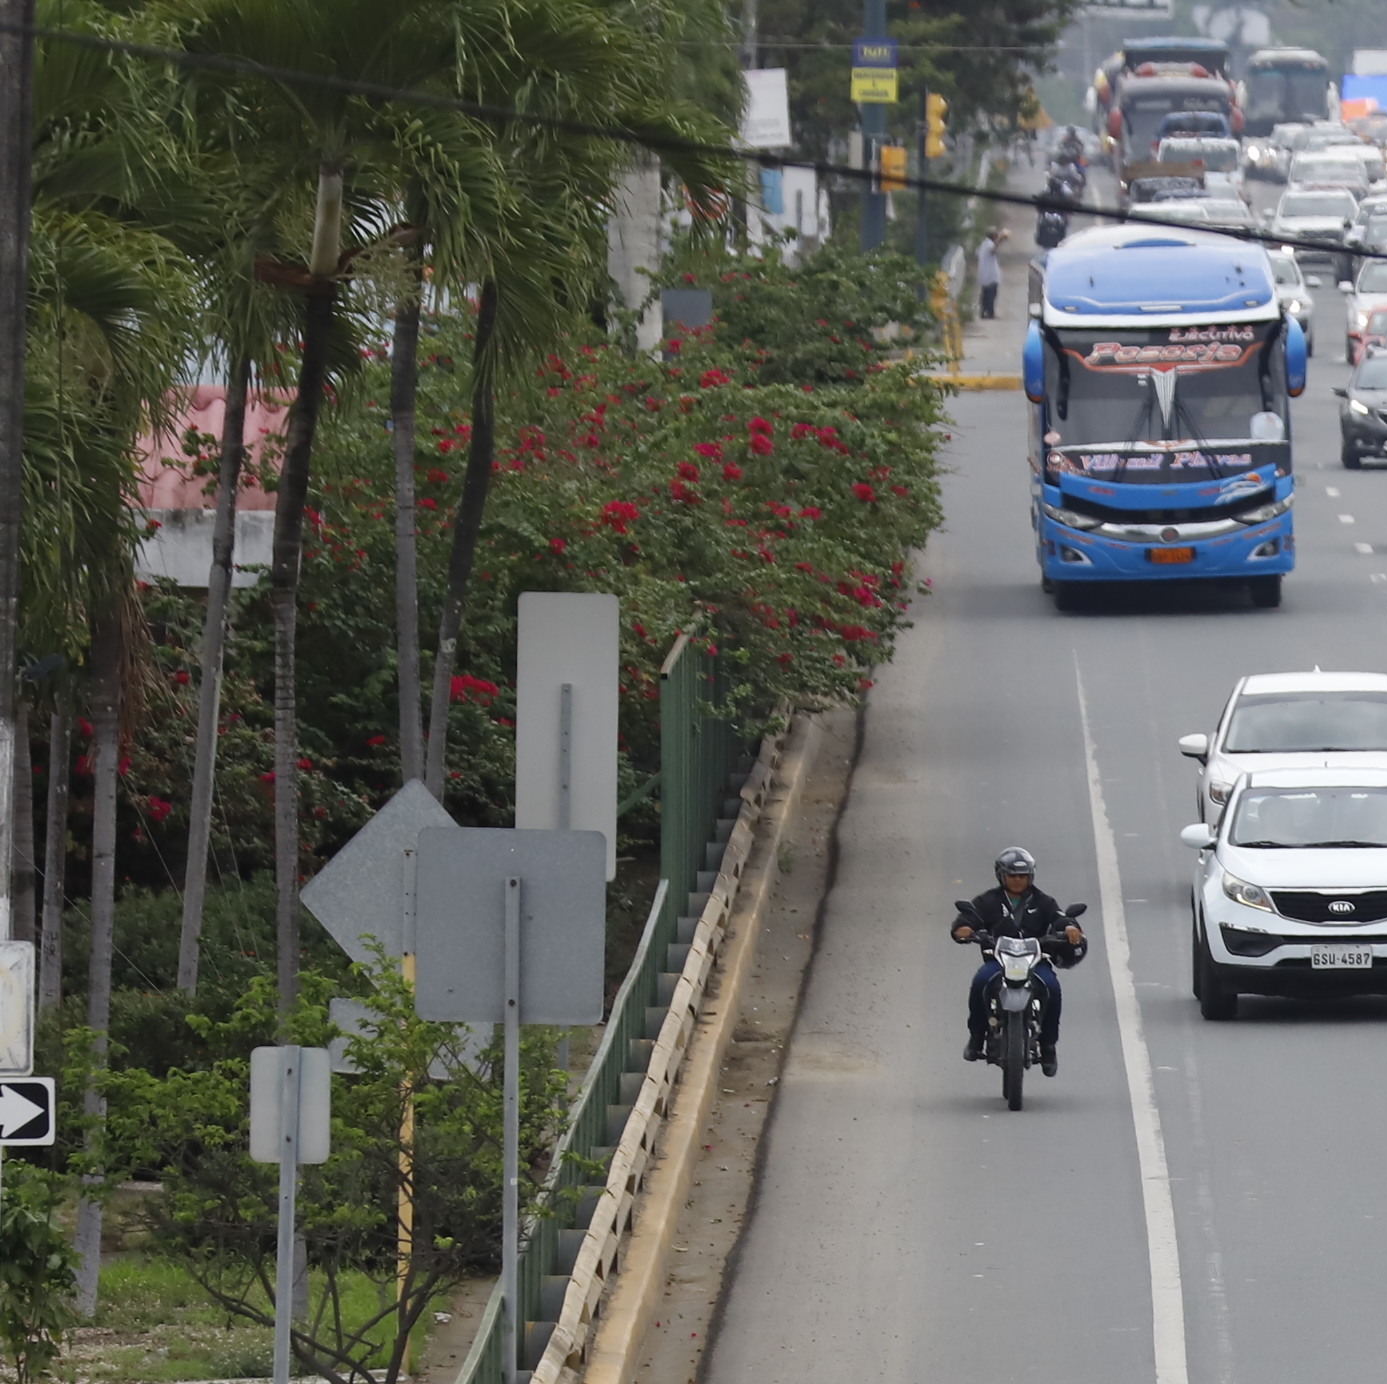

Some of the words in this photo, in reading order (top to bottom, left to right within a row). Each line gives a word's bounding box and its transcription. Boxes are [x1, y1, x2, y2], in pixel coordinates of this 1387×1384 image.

[1168, 330, 1255, 342] EJECUTIVO
[1333, 903, 1351, 912] KIA
[1313, 953, 1370, 966] GSU-4587
